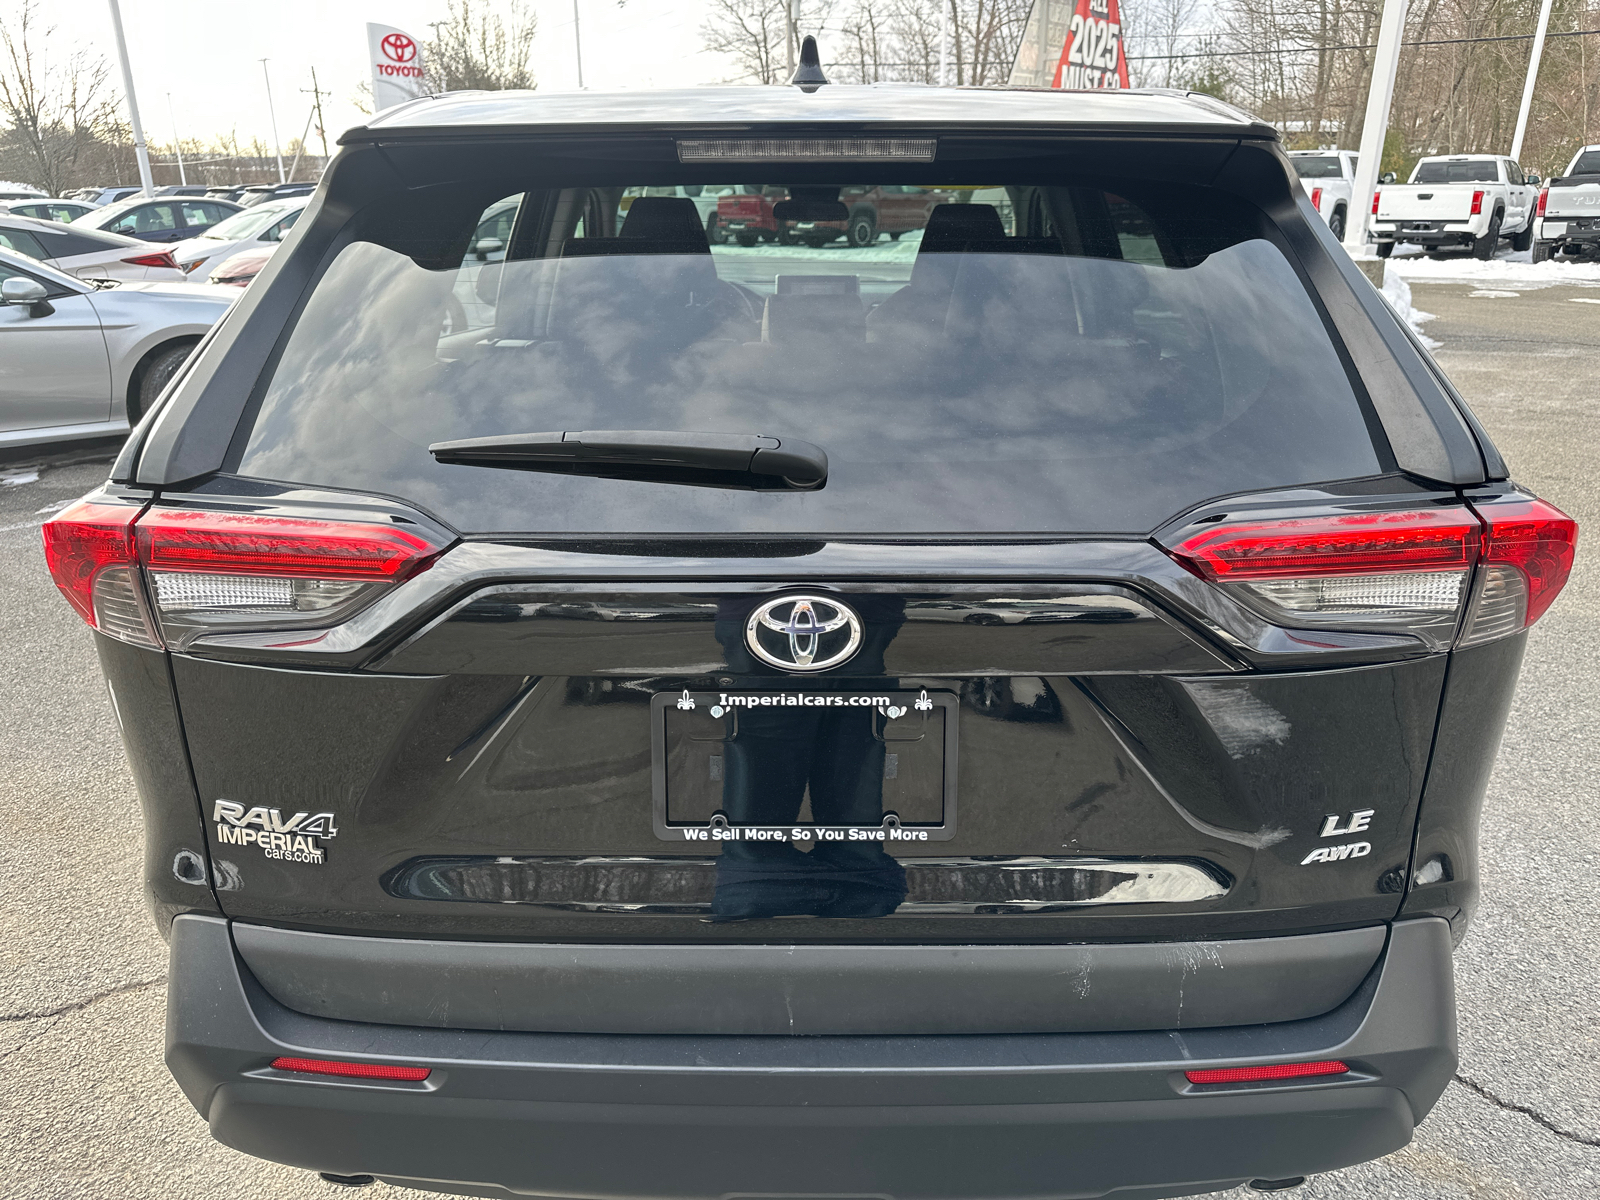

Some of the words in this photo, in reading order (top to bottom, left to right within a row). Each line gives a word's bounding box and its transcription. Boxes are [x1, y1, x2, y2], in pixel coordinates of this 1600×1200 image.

[1068, 14, 1120, 70] 2025
[376, 63, 424, 78] TOYOTA
[719, 693, 890, 708] Imperialcars.com
[213, 799, 339, 839] RAV4
[1319, 808, 1375, 837] LE
[217, 823, 324, 855] IMPERIAL
[683, 828, 708, 840] We
[712, 828, 740, 840] Sell
[744, 828, 787, 842] More,
[791, 828, 811, 840] So
[815, 828, 844, 840] You
[848, 828, 885, 840] Save
[889, 828, 928, 840] More
[264, 848, 322, 864] cars.com
[1300, 841, 1371, 865] AWD
